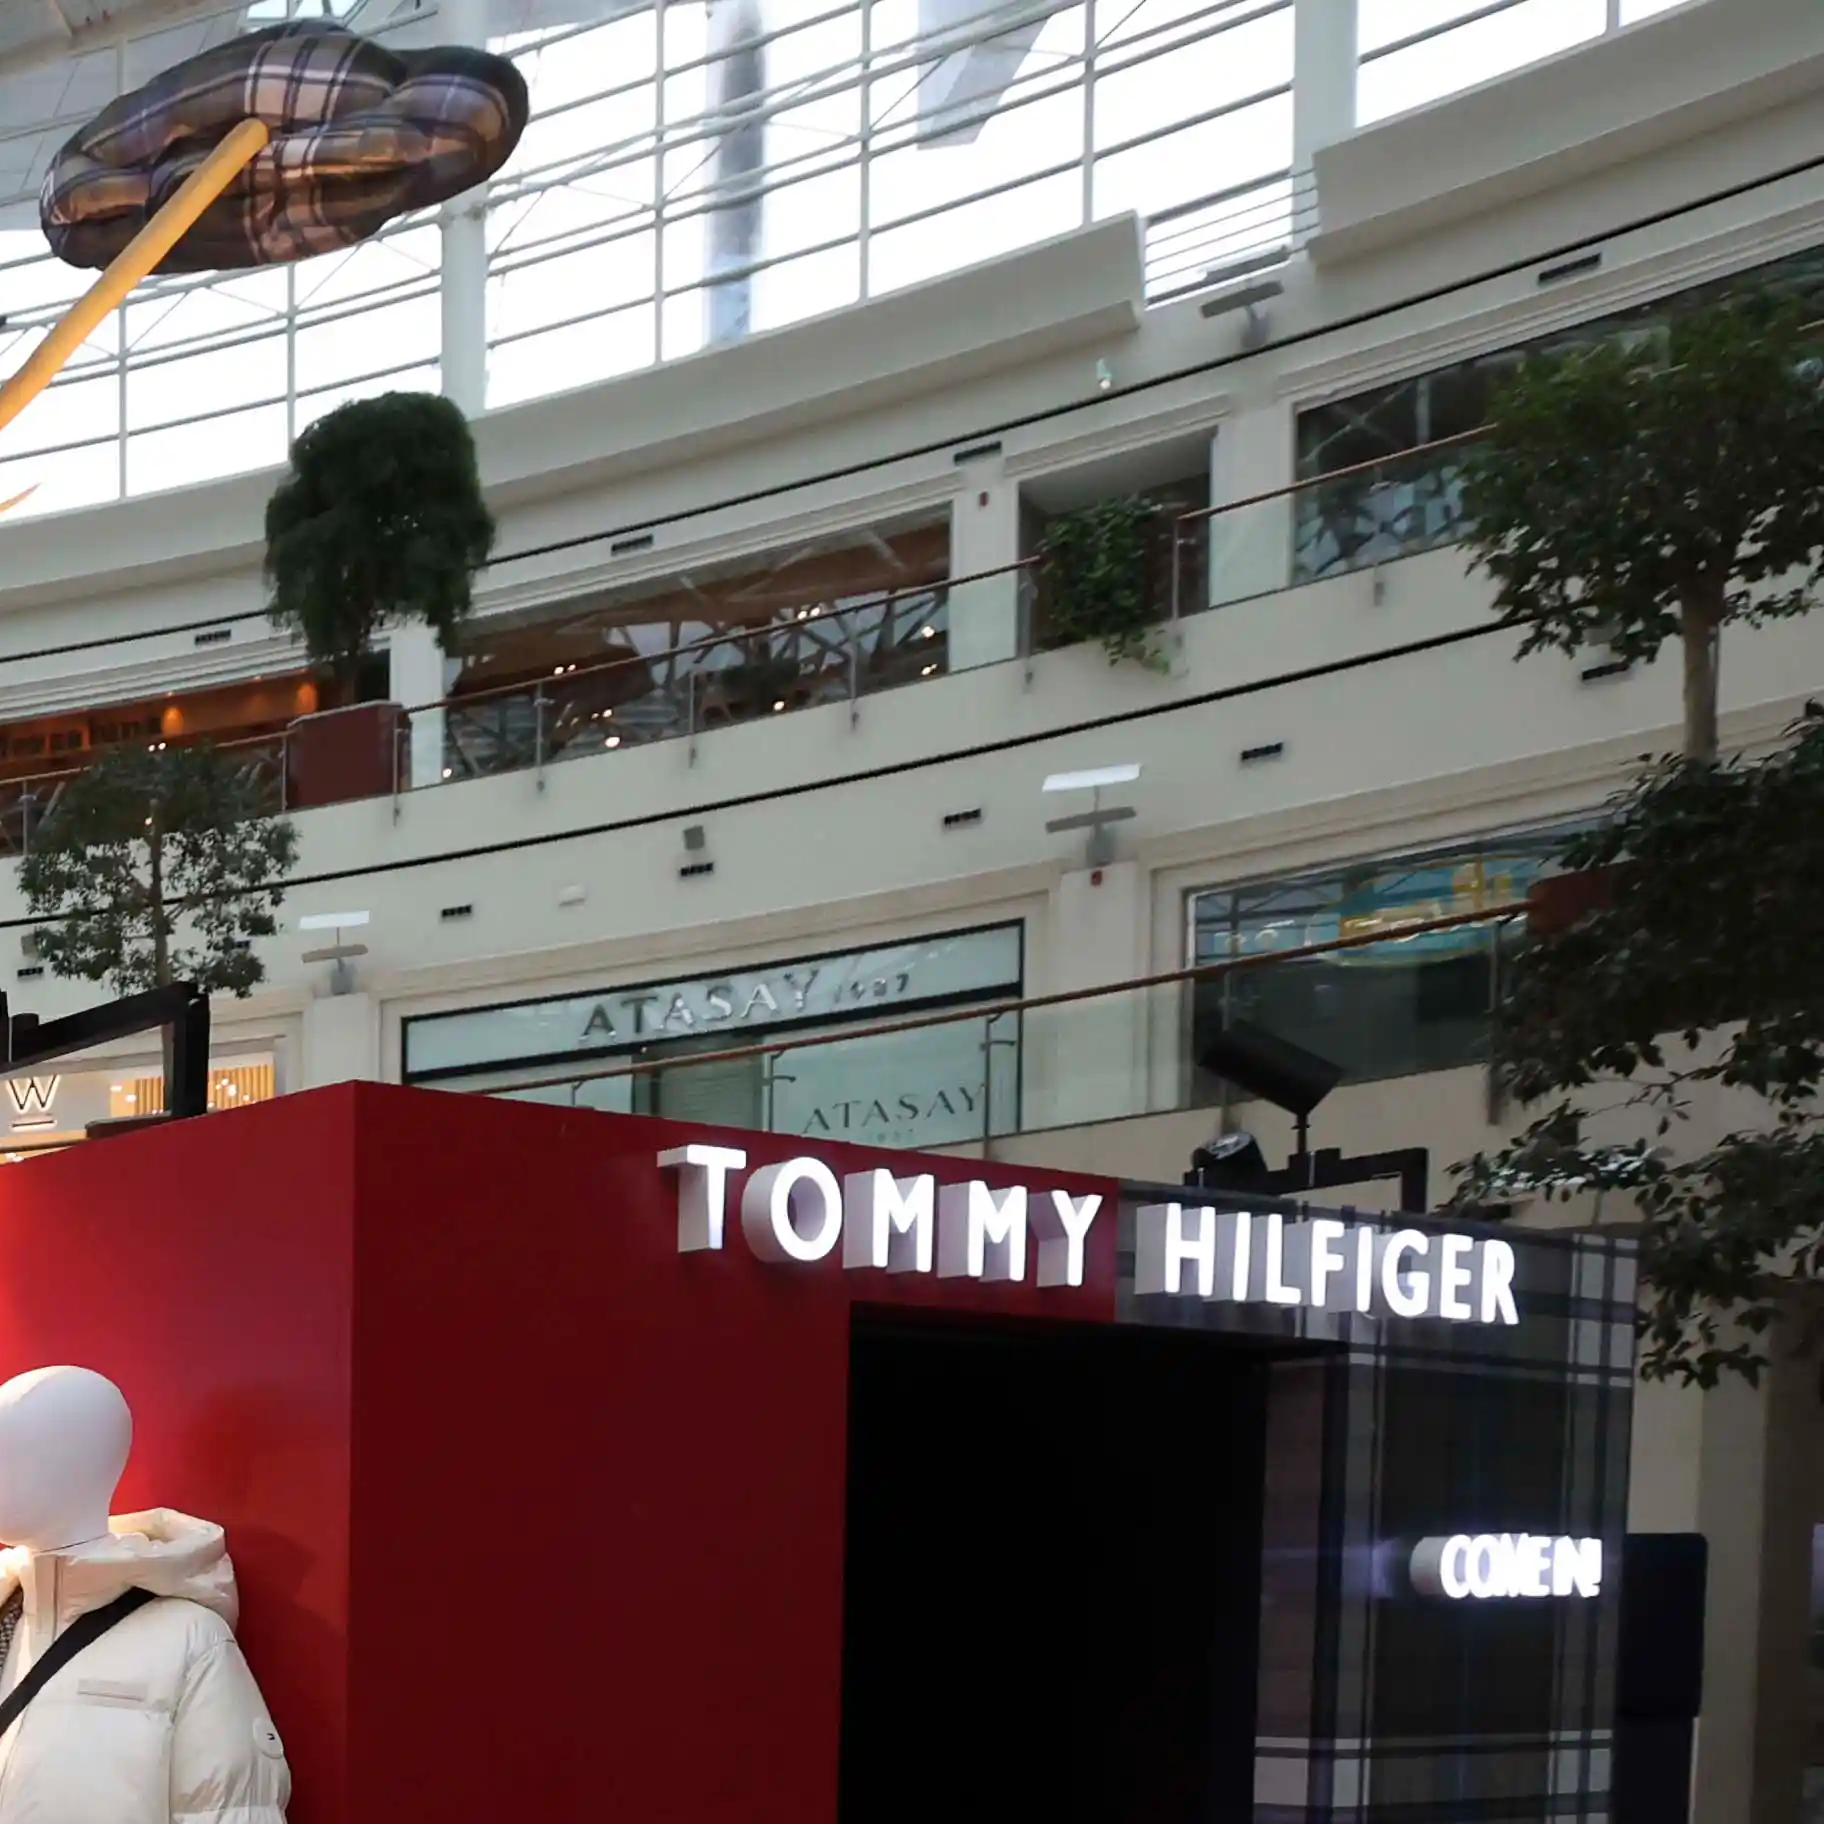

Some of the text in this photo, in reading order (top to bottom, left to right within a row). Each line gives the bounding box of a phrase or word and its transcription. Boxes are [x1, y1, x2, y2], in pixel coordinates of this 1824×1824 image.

[580, 969, 819, 1042] ATASAY
[803, 1083, 985, 1135] ATASAY
[660, 1143, 1520, 1327] TOMMY HILFIGER
